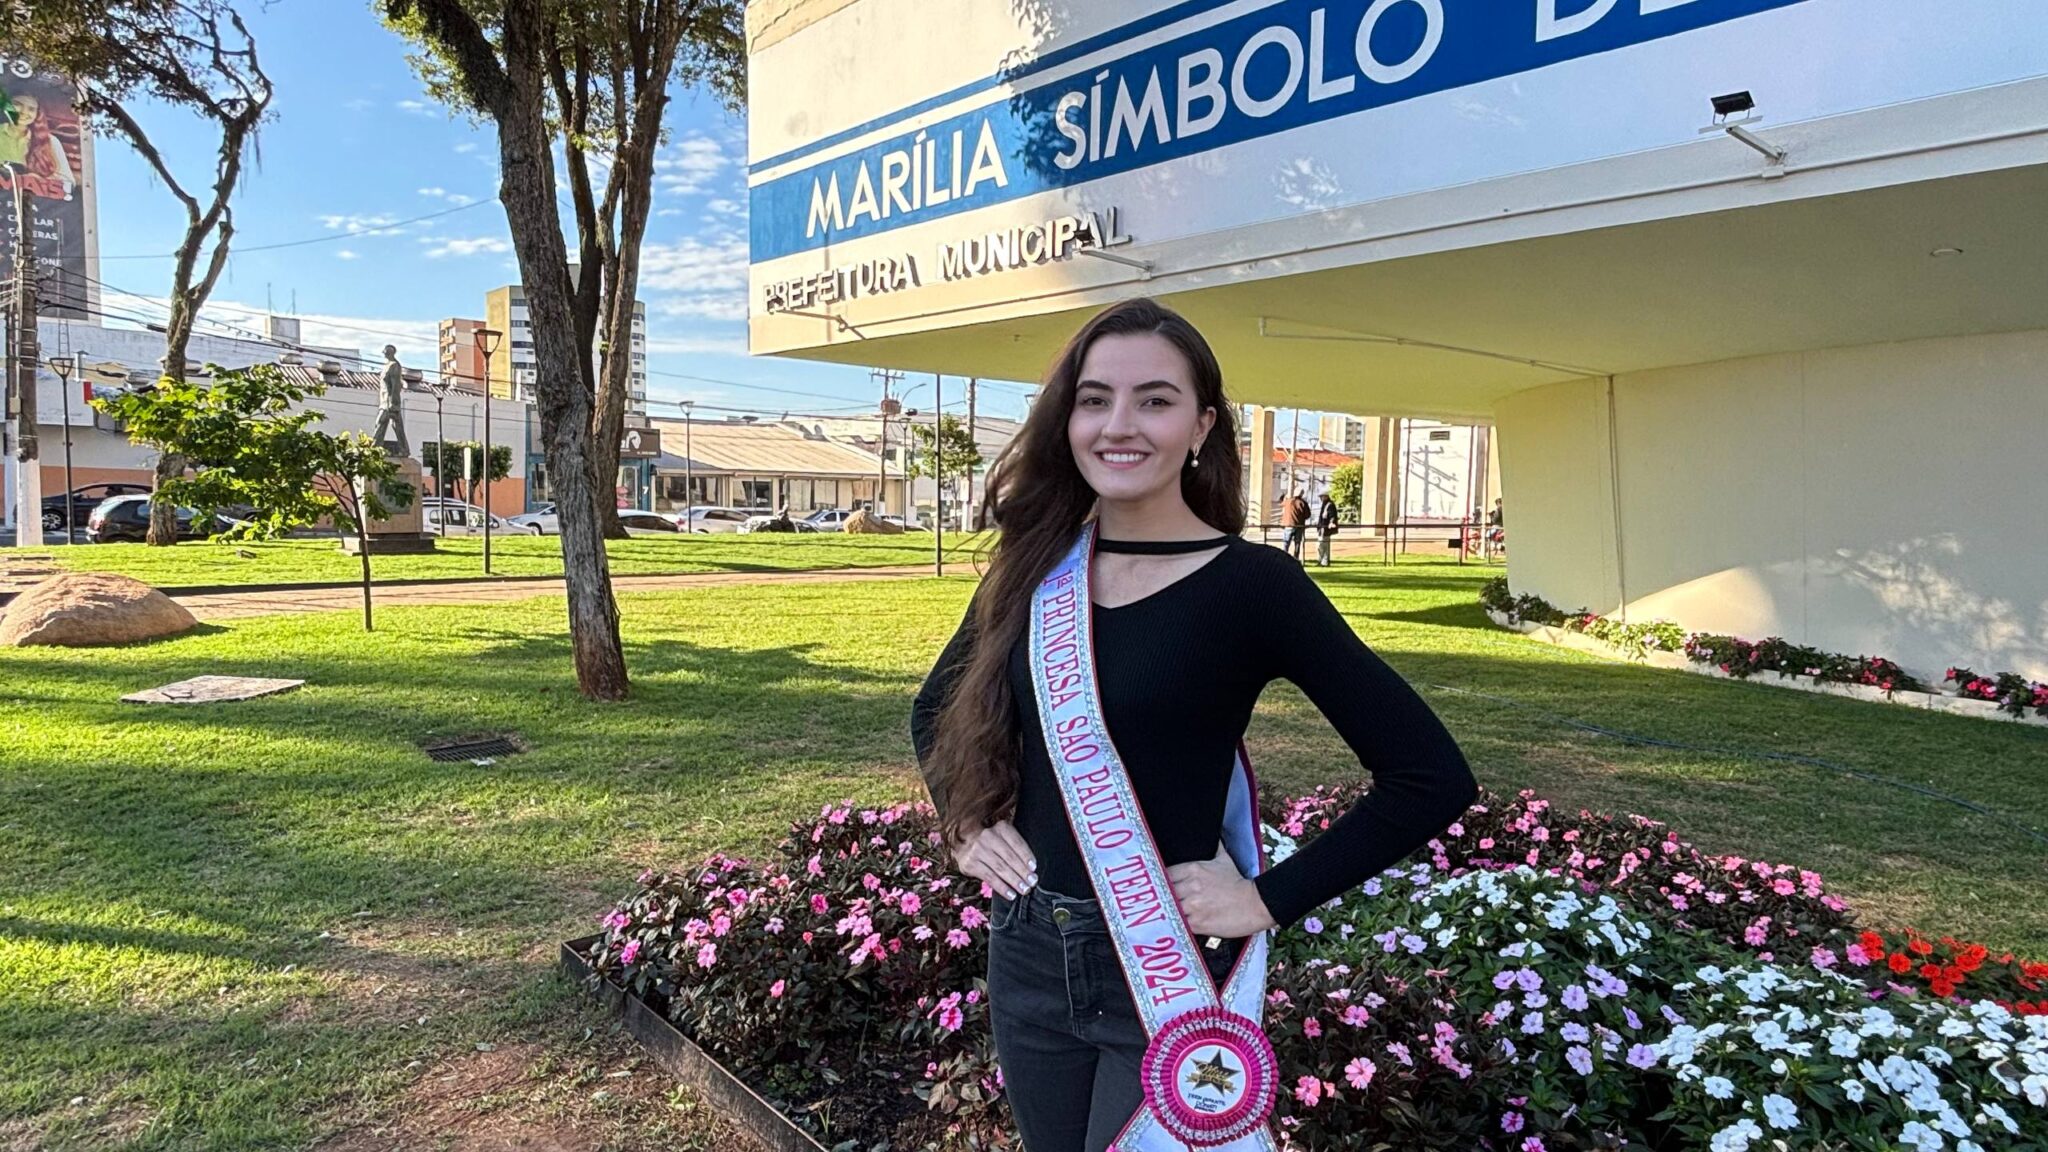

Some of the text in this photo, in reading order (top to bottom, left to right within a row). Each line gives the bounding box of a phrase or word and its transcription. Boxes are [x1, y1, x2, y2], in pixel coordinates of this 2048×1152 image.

[806, 0, 1444, 239] MARÍLIA SÍMBOLO
[763, 206, 1133, 312] PREFEITURA MUNICIPAL
[1042, 587, 1083, 711] PRINCESA
[1072, 765, 1133, 849] PAULO
[1104, 854, 1166, 929] TEEN
[1132, 937, 1197, 1007] 2024
